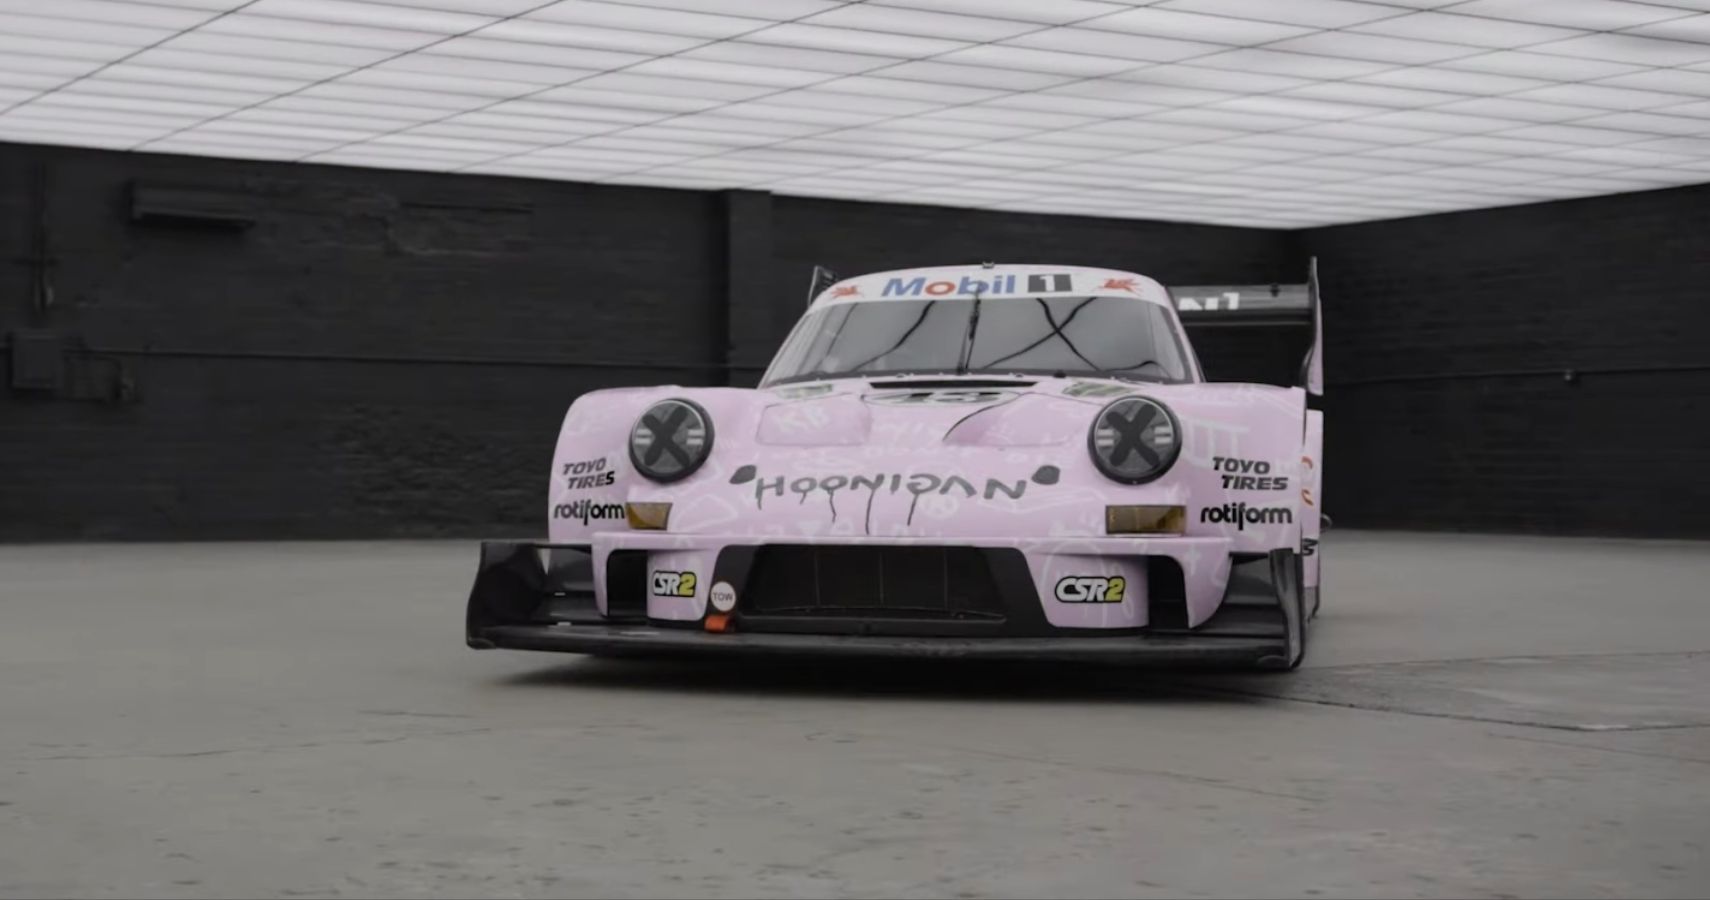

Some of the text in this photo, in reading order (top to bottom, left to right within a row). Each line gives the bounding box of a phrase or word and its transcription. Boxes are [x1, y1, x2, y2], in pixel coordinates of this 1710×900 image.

[881, 275, 1016, 297] Mobil
[562, 457, 607, 476] TOYO
[1212, 456, 1271, 475] TOYO
[567, 470, 616, 490] TIRES
[1221, 474, 1290, 491] TIRES
[755, 472, 1028, 513] HOONIGAN
[553, 499, 626, 526] rotiform
[1200, 502, 1293, 531] rotiform
[652, 571, 697, 597] CSR2
[1055, 577, 1125, 602] CSR2
[711, 591, 733, 602] TOW
